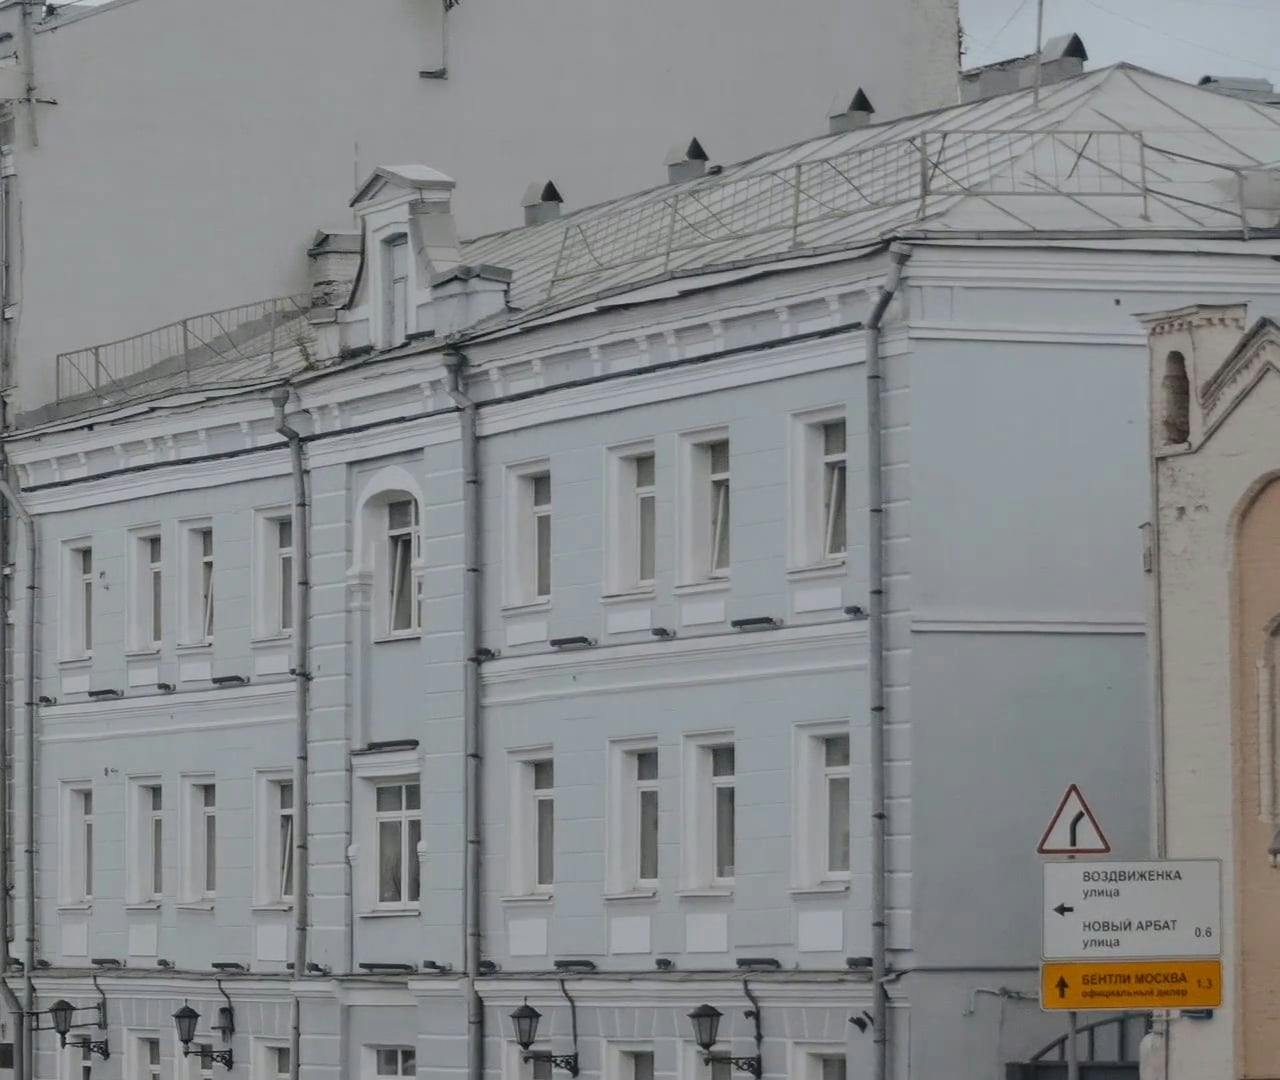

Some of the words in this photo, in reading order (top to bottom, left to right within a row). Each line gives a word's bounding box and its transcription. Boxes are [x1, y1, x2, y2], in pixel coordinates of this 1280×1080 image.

[1082, 870, 1182, 882] ВОЗДВИЖЕНКА
[1082, 887, 1120, 900] улица
[1082, 919, 1132, 932] НОВЫЙ
[1136, 920, 1178, 932] АРБАТ
[1194, 926, 1213, 938] 0.6
[1082, 937, 1121, 950] улица
[1081, 974, 1130, 986] БЕНТЛИ
[1134, 973, 1188, 985] МОСКВА
[1196, 978, 1213, 990] 1.3
[1081, 988, 1154, 1000] официальный
[1156, 987, 1188, 999] дилер
